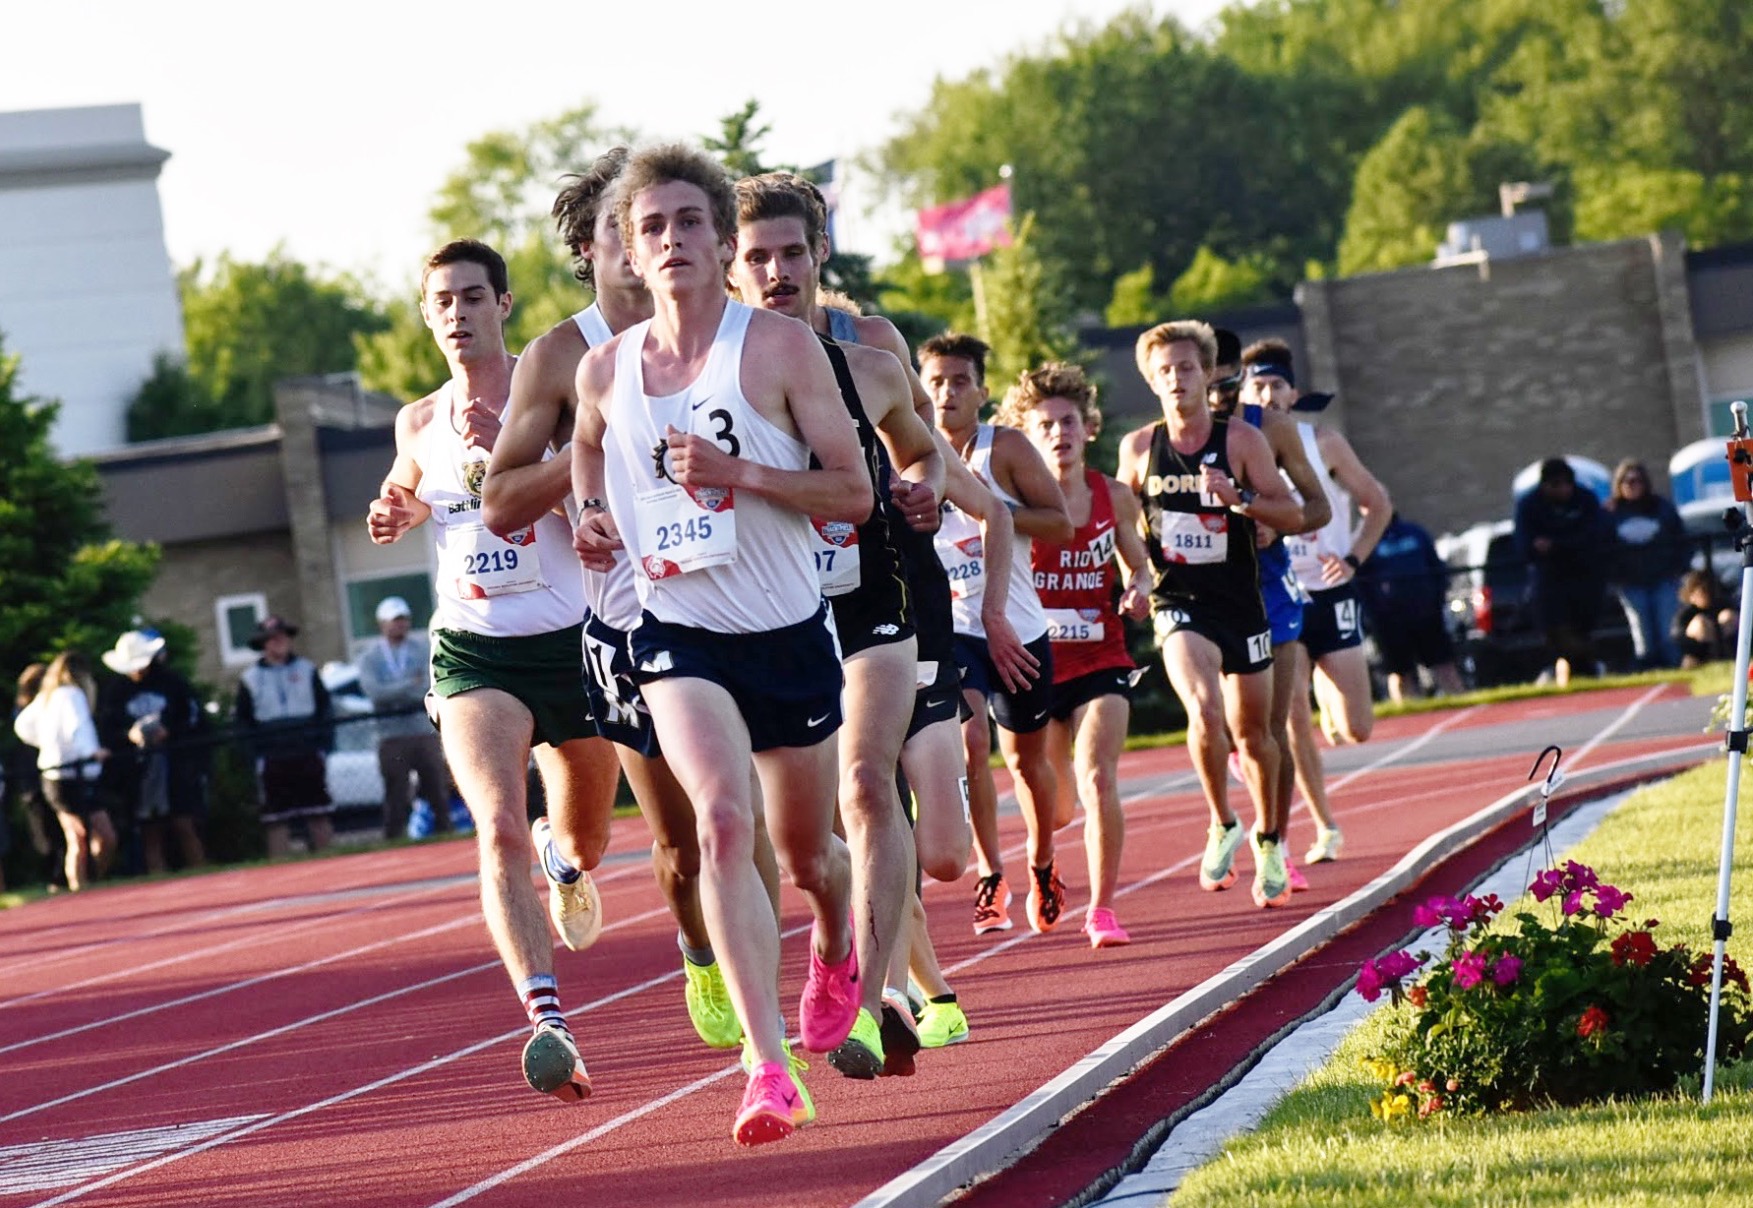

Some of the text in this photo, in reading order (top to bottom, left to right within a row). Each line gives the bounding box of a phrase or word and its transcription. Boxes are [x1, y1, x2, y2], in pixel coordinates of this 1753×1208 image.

[709, 409, 740, 457] 3
[1148, 474, 1234, 496] DOR
[657, 515, 712, 551] 2345
[1175, 534, 1212, 548] 1811
[464, 549, 518, 574] 2219
[1060, 550, 1092, 568] RIO
[946, 560, 981, 580] 228
[1034, 571, 1105, 590] GRANDE
[1048, 625, 1089, 640] 2215
